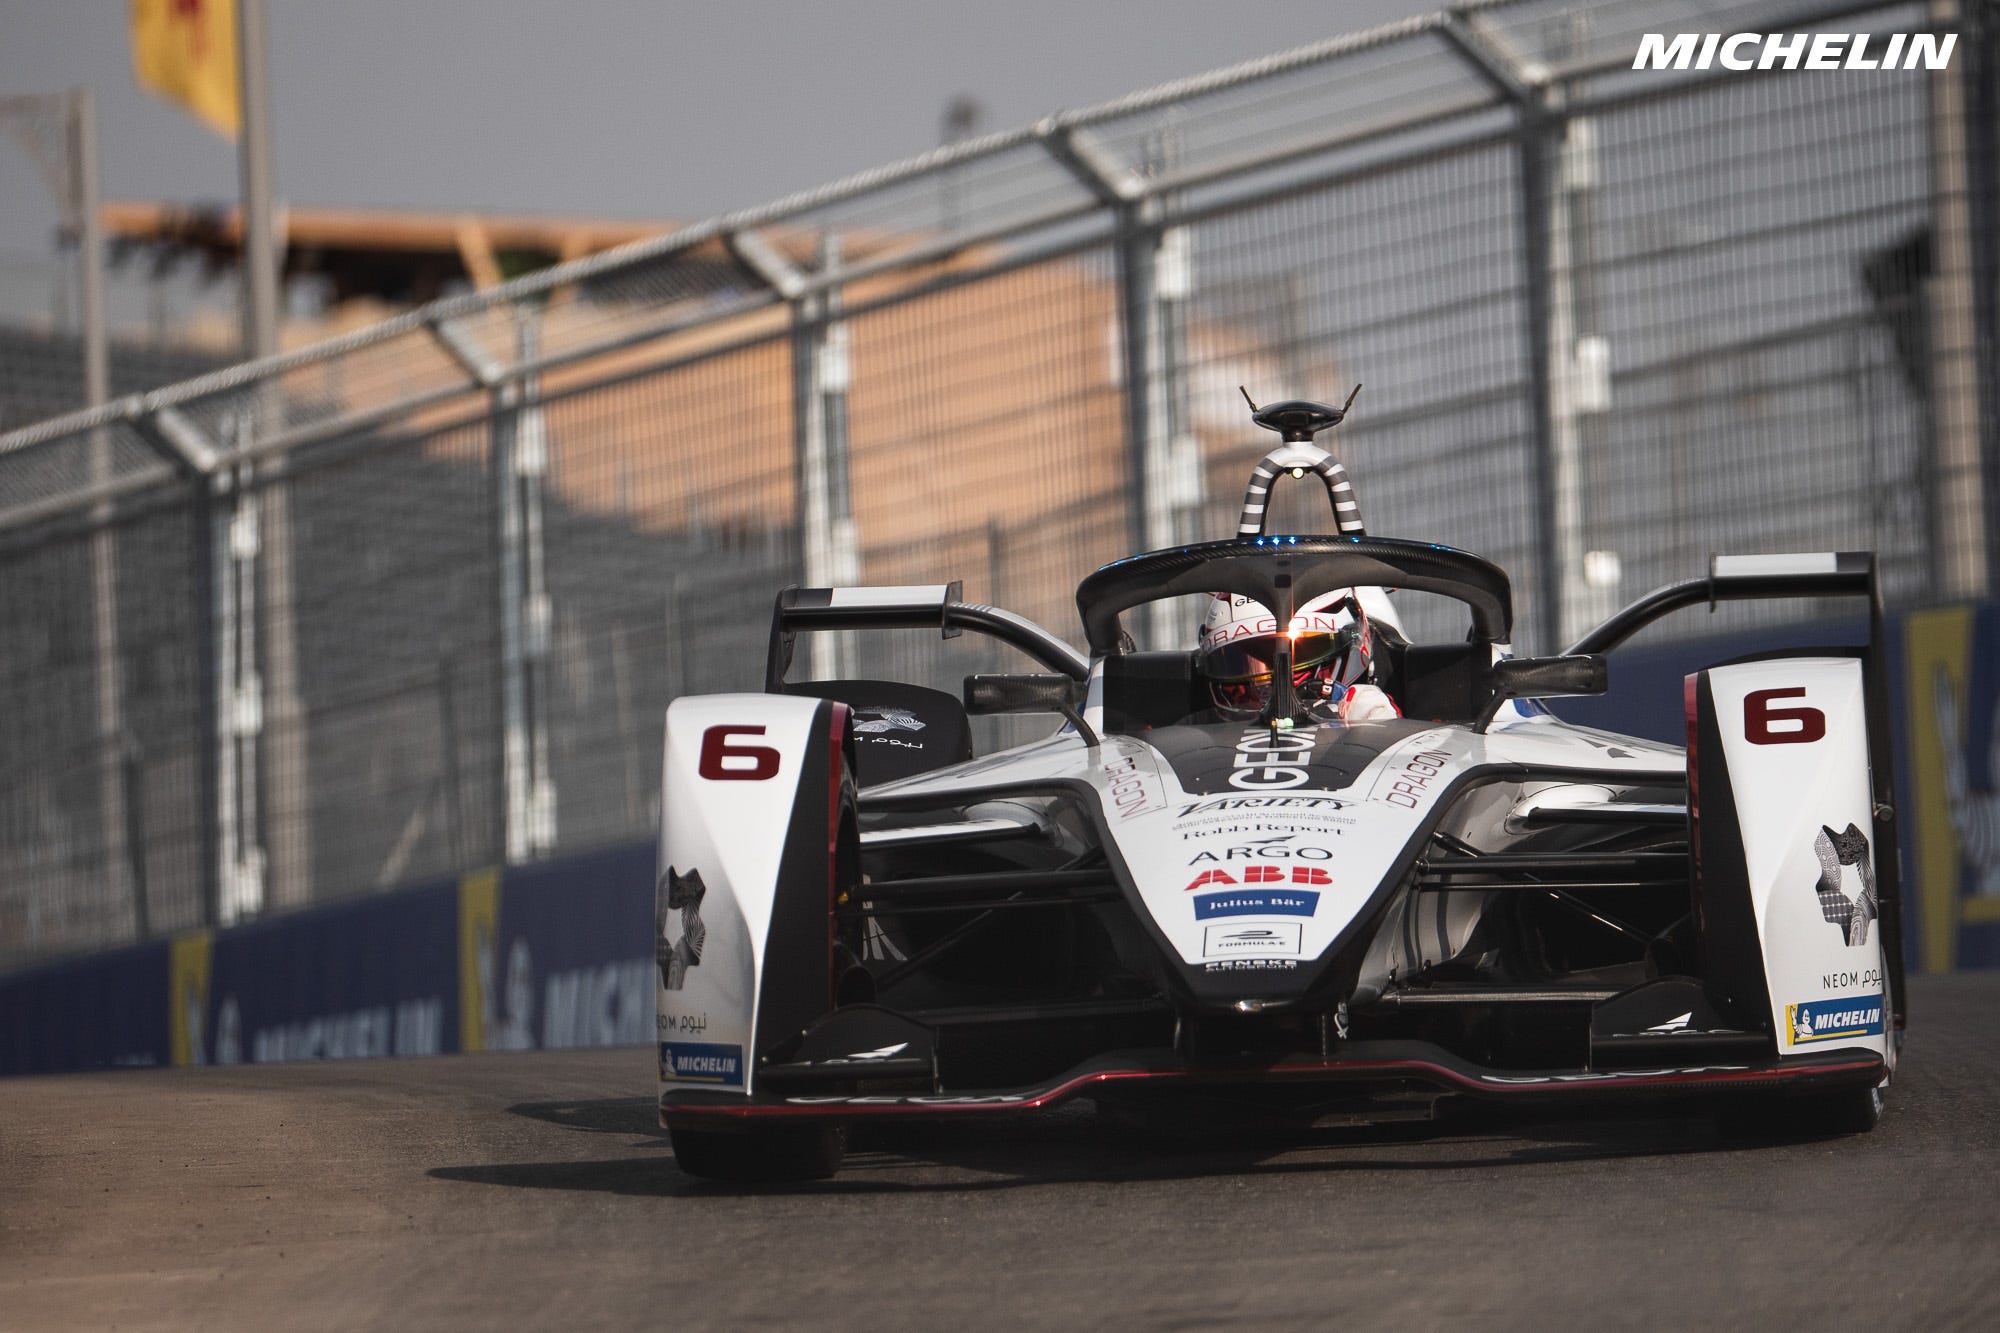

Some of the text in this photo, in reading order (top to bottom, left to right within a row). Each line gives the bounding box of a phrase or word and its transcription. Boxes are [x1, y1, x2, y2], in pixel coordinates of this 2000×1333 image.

[1744, 687, 1825, 745] 6
[699, 724, 780, 781] 6
[1104, 757, 1147, 818] DRAGON
[1386, 749, 1453, 809] DRAGON
[1183, 823, 1344, 840] Robb Report
[1188, 846, 1333, 866] ARGO
[1184, 866, 1334, 891] ABB
[1209, 899, 1264, 910] Julius
[1823, 971, 1858, 990] NEOM
[1814, 1008, 1880, 1030] MICHELIN
[677, 1055, 735, 1073] MICHELIN
